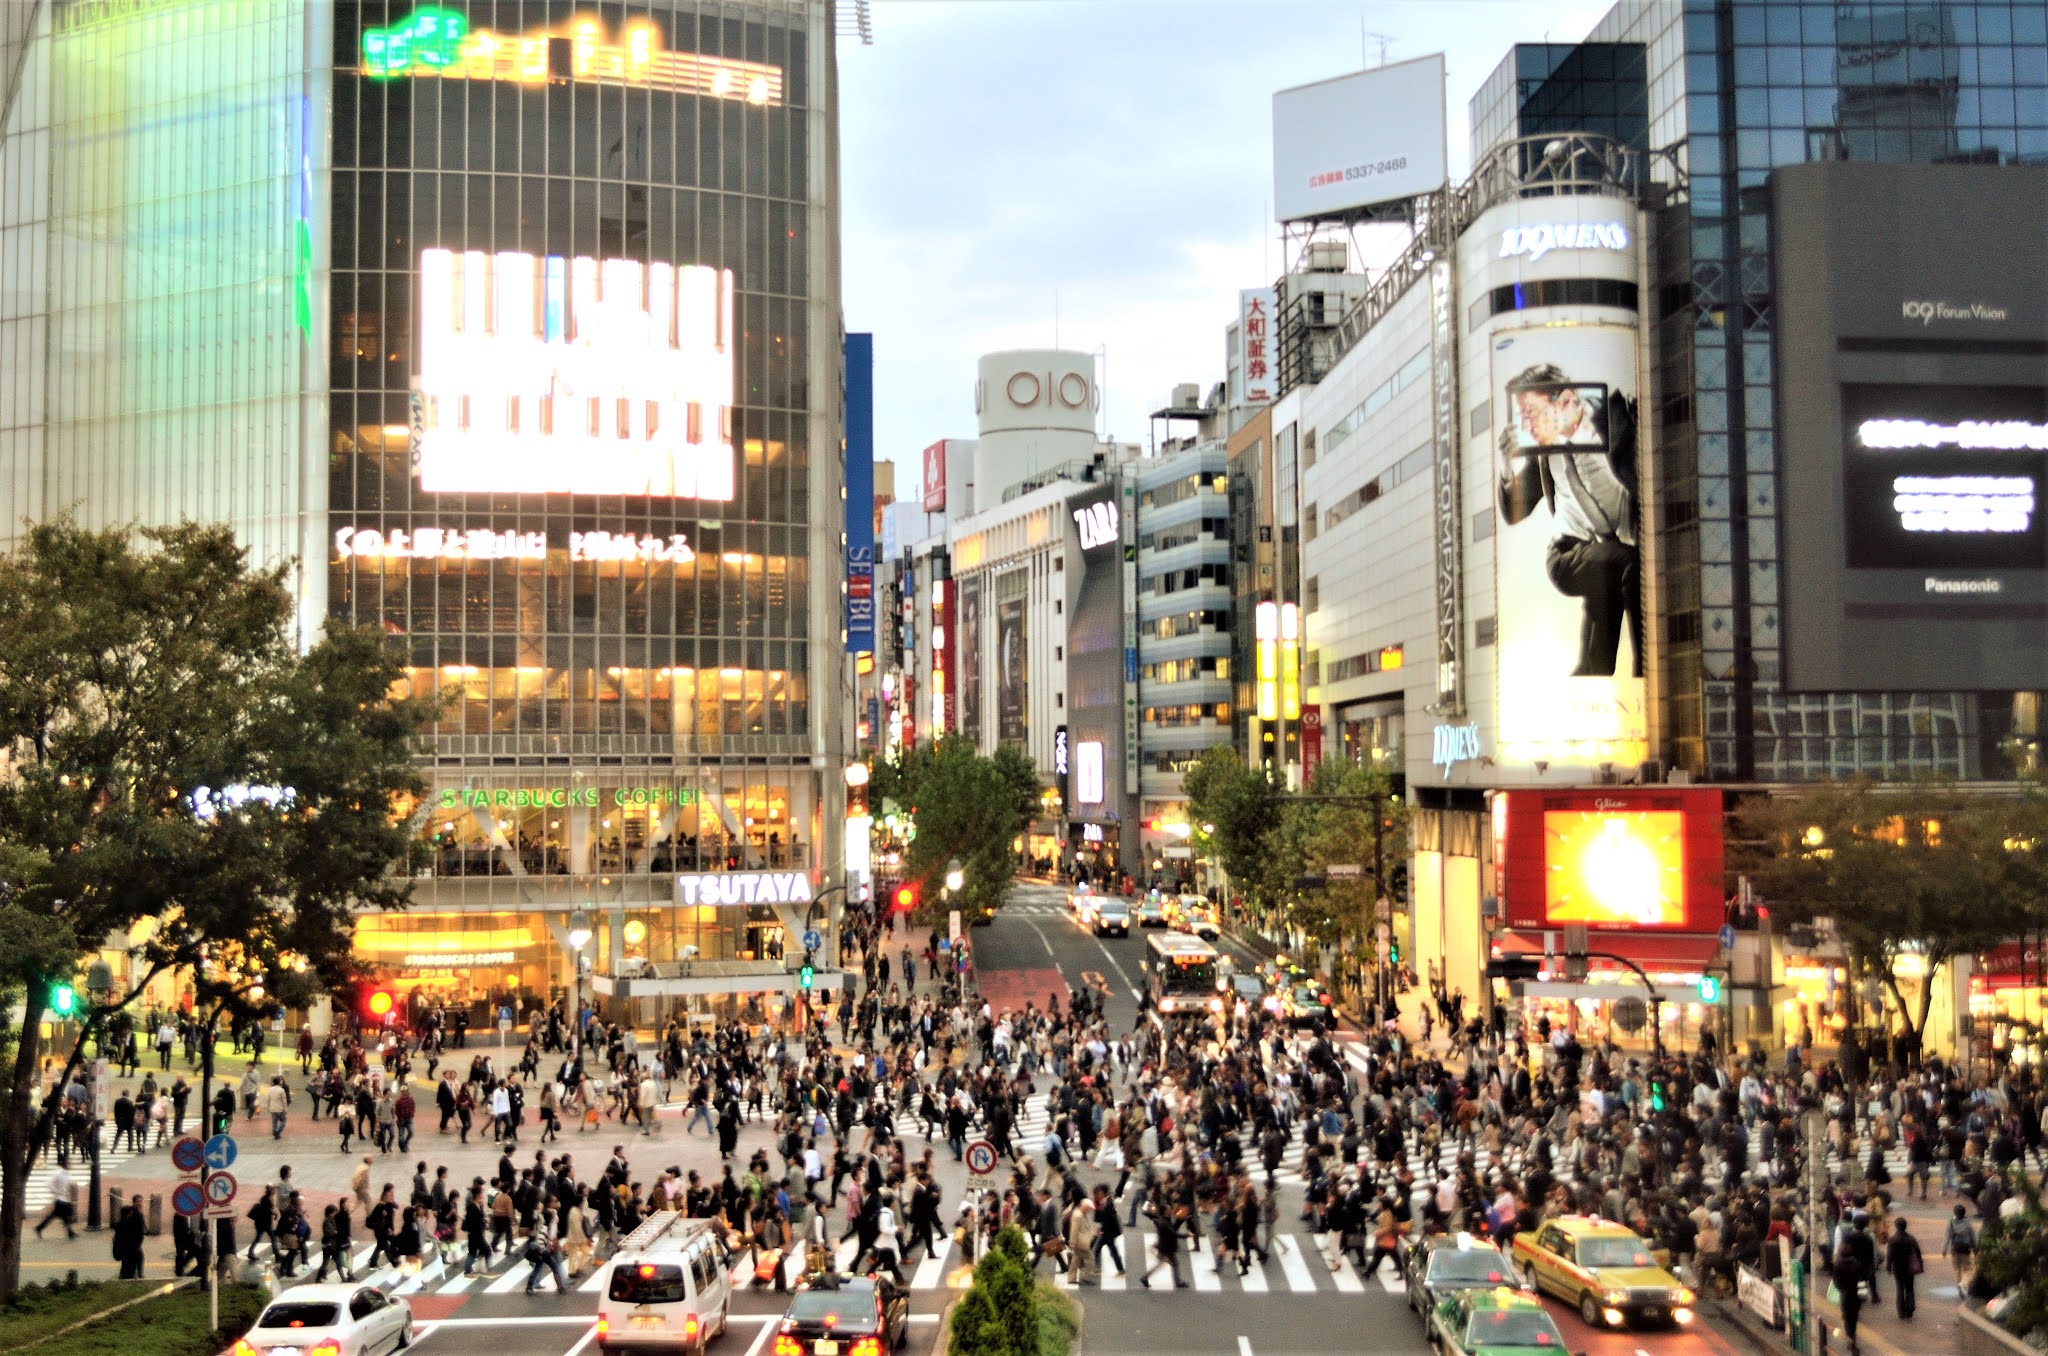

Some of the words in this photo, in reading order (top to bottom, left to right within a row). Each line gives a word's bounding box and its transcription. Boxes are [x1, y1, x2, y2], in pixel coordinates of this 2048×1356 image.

[1902, 301, 1934, 325] 109
[1936, 301, 1971, 320] Forum
[1970, 303, 2005, 320] Vision
[1246, 297, 1267, 380] 大和証券
[1439, 359, 1451, 447] SUIT
[1073, 500, 1119, 550] ZARA
[1440, 457, 1454, 652] COMPANY
[849, 546, 872, 633] SEIBU
[1924, 577, 1999, 592] Panasonic
[1055, 731, 1068, 774] ZARA
[440, 787, 600, 809] STARBUCKS
[614, 787, 704, 807] COFFEE
[679, 873, 812, 905] TSUTAYA
